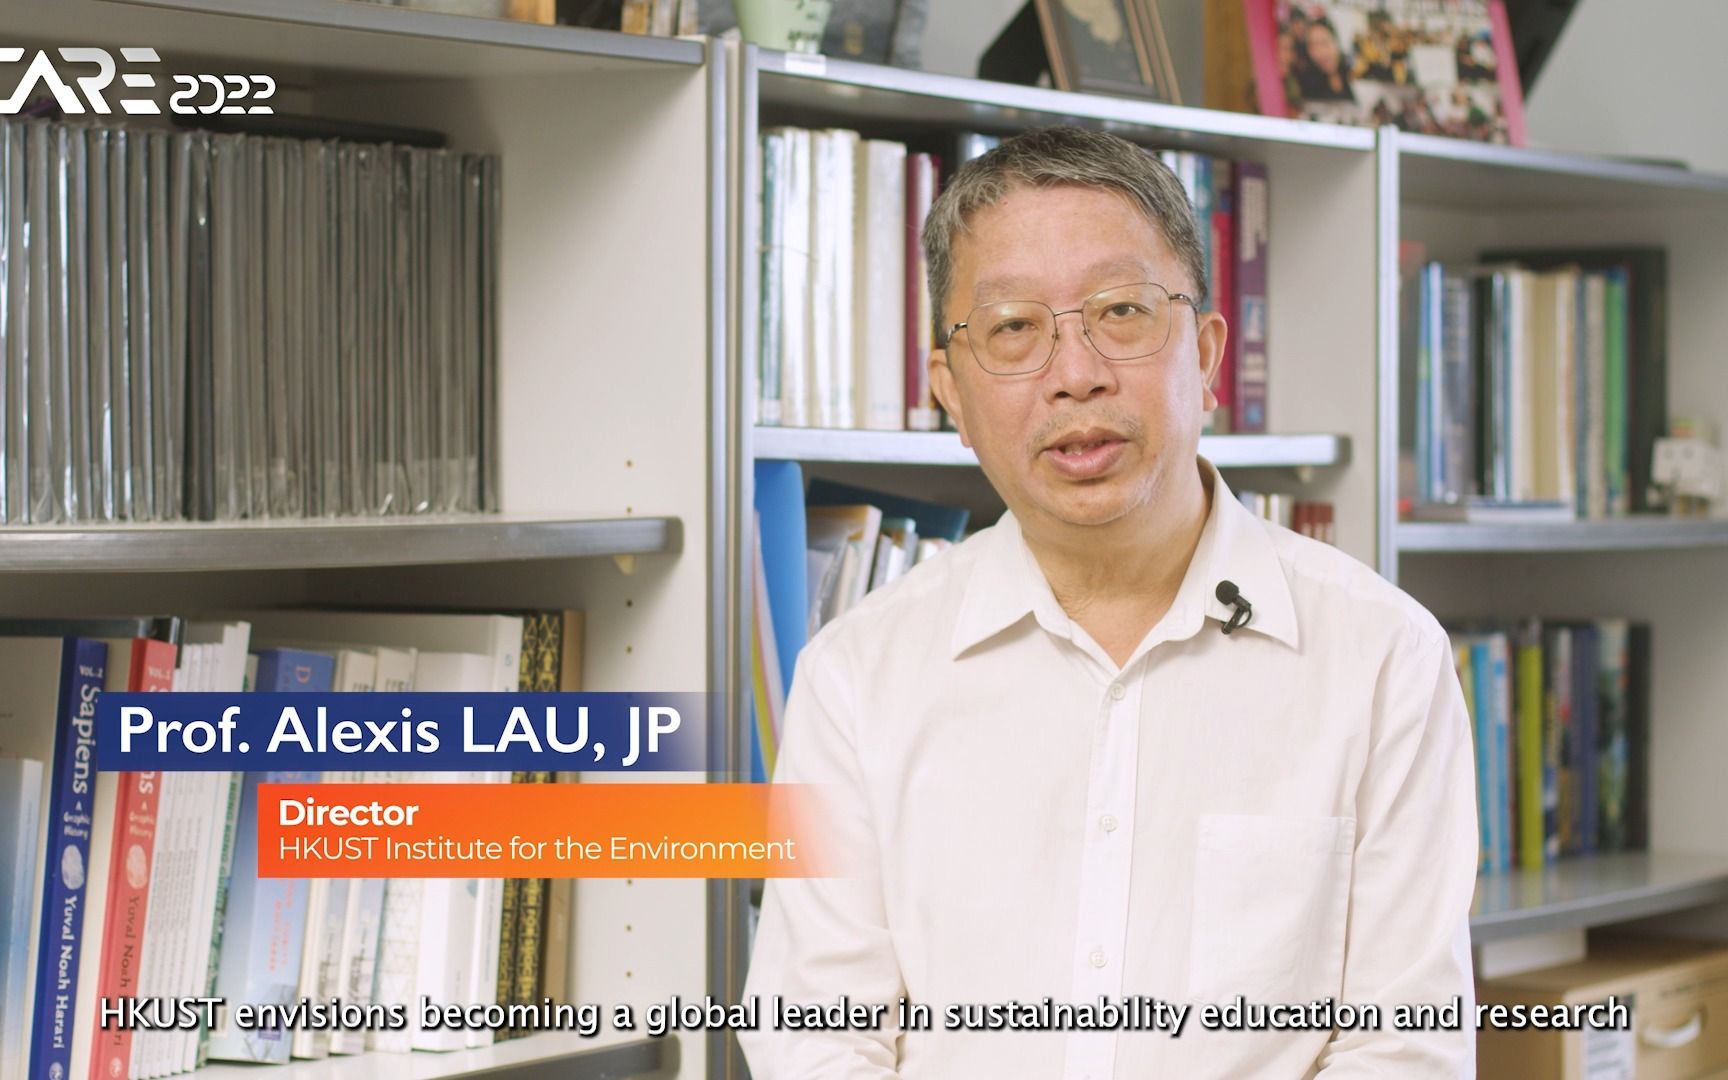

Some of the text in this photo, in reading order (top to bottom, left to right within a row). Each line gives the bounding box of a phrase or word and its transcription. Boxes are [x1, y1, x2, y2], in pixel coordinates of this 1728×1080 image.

[72, 684, 101, 794] Sapiens
[124, 896, 140, 940] Yuval
[53, 895, 78, 1049] Yuval Noah Harari
[119, 945, 135, 988] Noah
